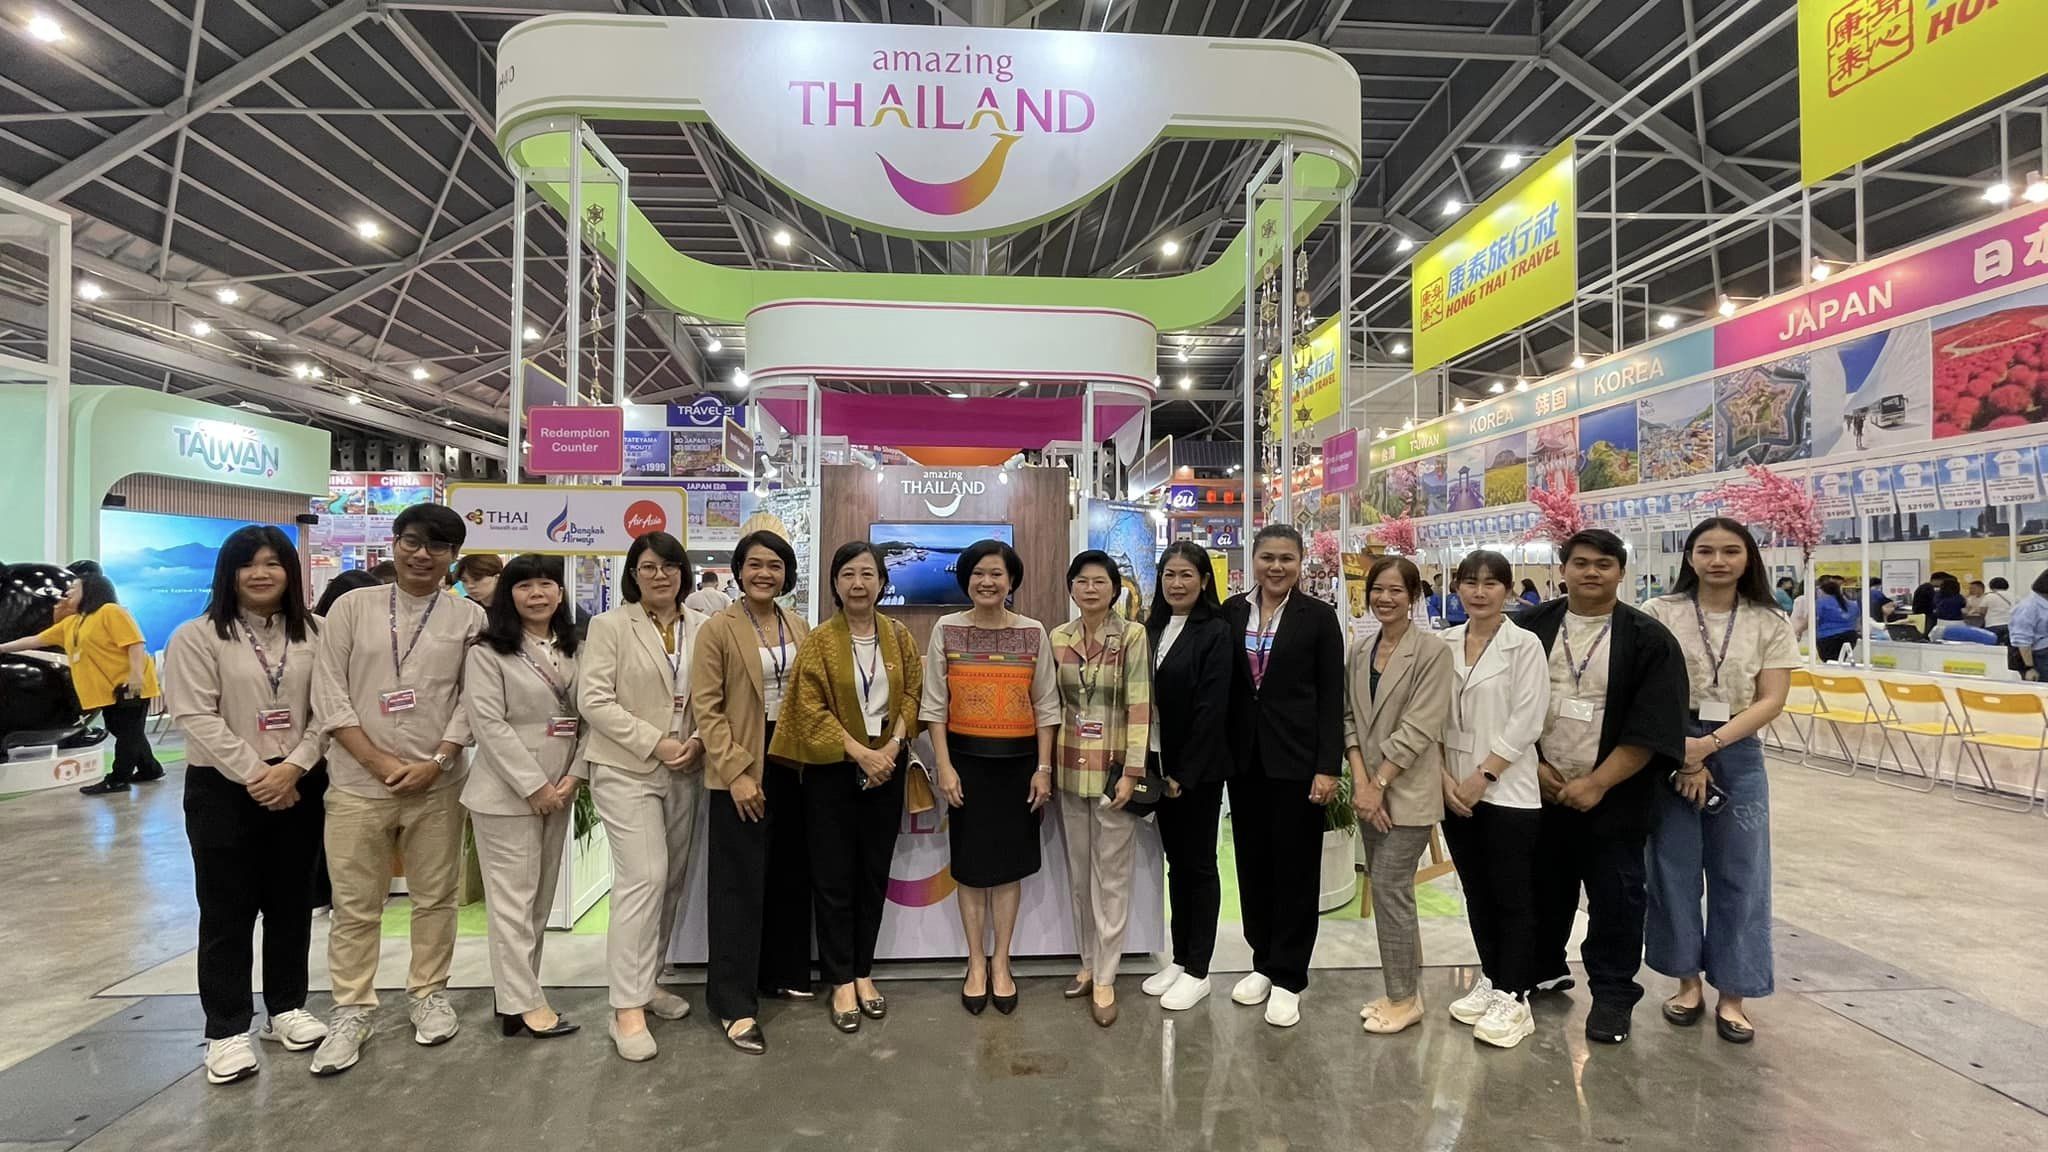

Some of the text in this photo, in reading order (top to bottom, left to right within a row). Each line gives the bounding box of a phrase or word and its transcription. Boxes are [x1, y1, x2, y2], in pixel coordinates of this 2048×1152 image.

[1926, 0, 1999, 44] HO
[872, 45, 1014, 82] amazing
[788, 80, 1096, 134] THAILAND
[1446, 200, 1560, 300] 康泰旅行社
[1446, 239, 1561, 318] HONG THAI TRAVEL
[1778, 280, 1892, 342] JAPAN
[1593, 357, 1665, 396] KOREA
[677, 406, 735, 416] TRAVEL 21
[1469, 407, 1514, 434] KOREA
[540, 427, 610, 439] Redemption
[552, 442, 599, 452] Counter
[1409, 433, 1440, 452] TAIWAN
[174, 427, 279, 475] TAIWAN
[329, 477, 353, 485] INA
[381, 477, 420, 486] CHINA
[922, 470, 963, 480] amazing
[901, 480, 985, 495] THAILAND
[1173, 491, 1196, 508] eu
[486, 511, 528, 524] THAI
[627, 514, 662, 528] AirAsia
[570, 522, 605, 536] Bangkok
[562, 531, 594, 545] Airways
